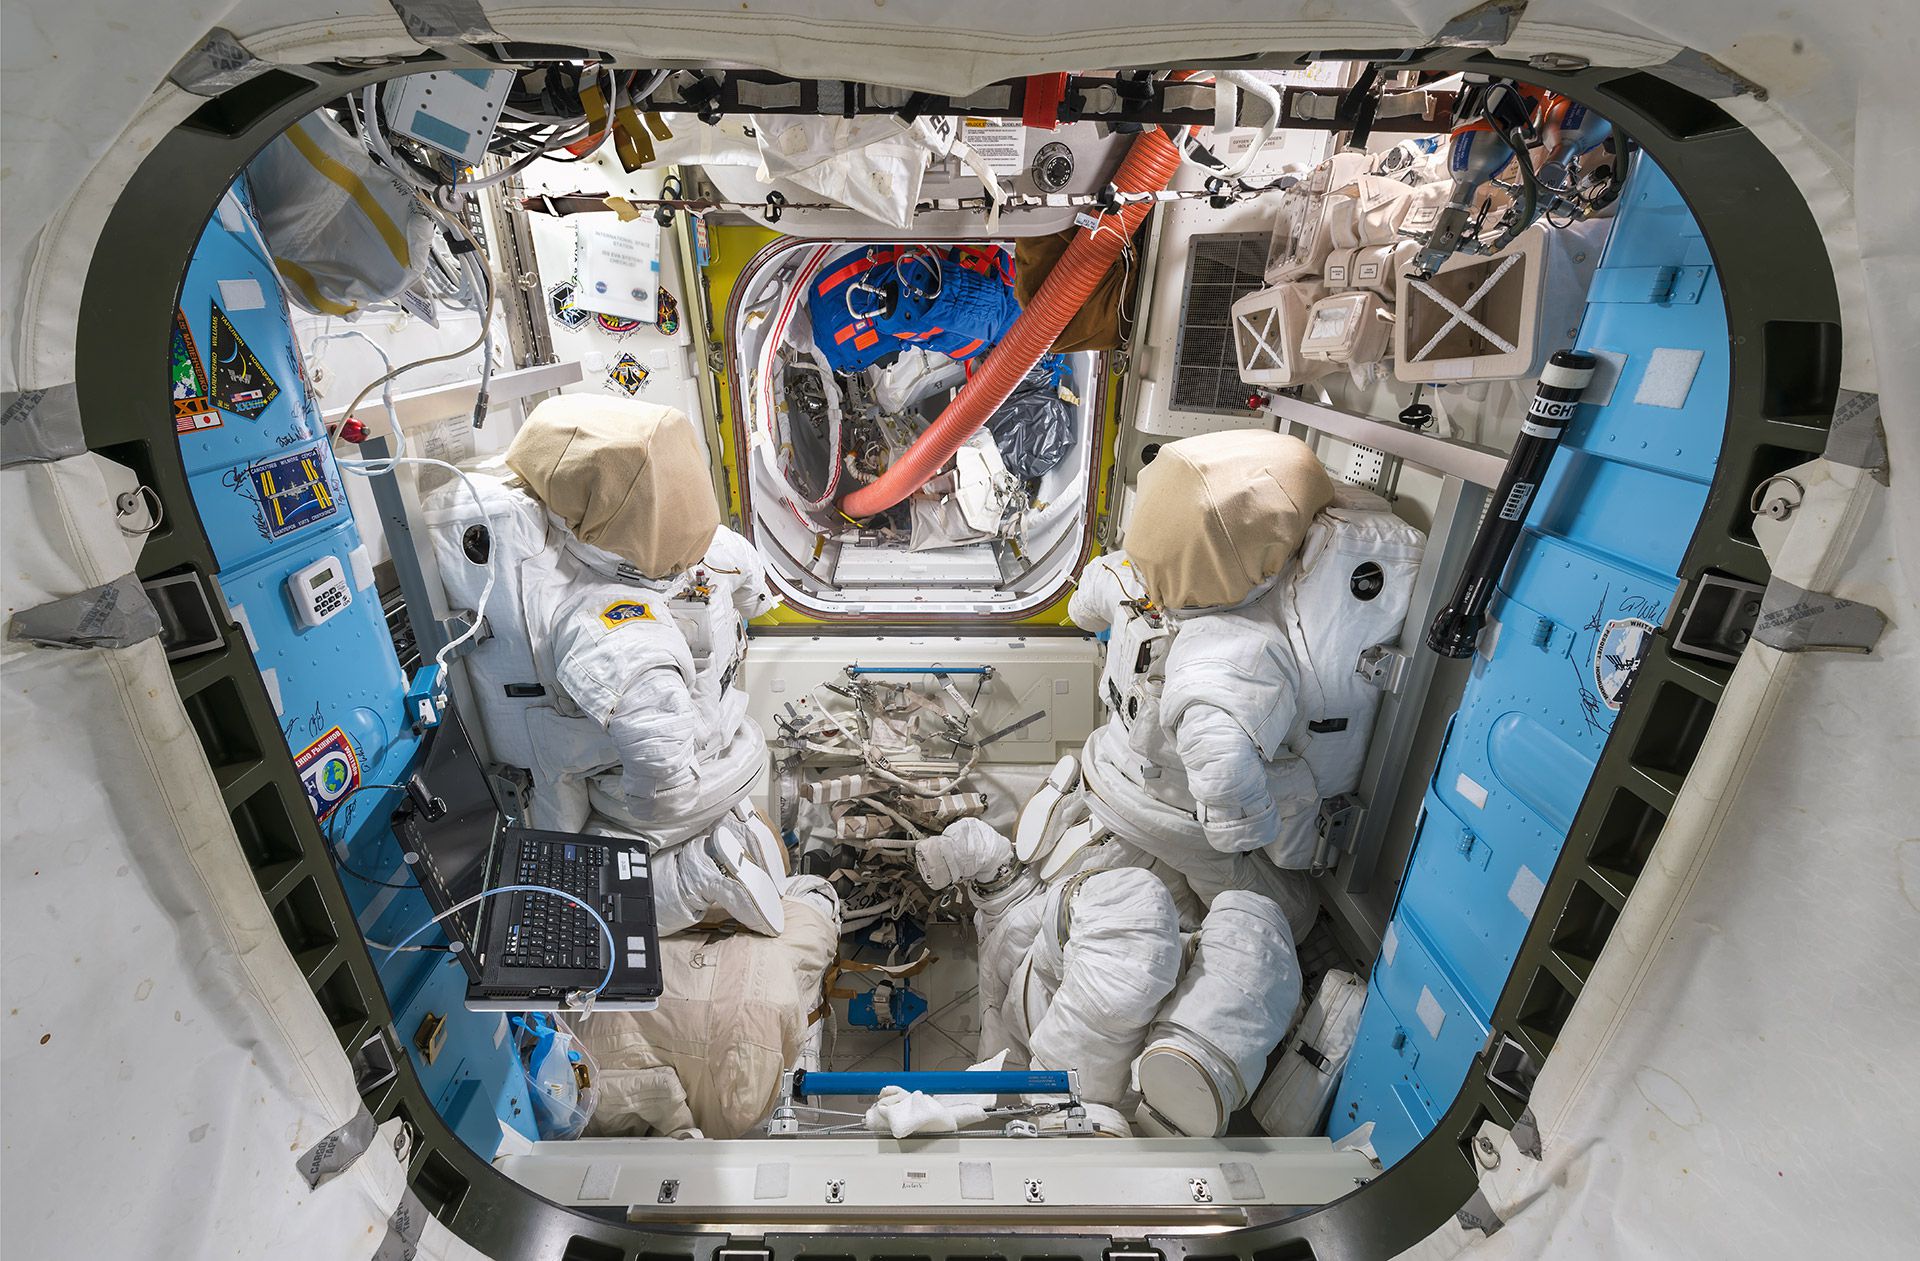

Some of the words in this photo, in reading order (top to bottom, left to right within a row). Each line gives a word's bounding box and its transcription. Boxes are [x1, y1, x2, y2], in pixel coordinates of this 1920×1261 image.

[409, 14, 437, 36] PIT
[203, 41, 243, 59] RGO
[595, 231, 633, 244] INTERNATIONAL
[613, 241, 634, 250] STATION
[310, 1140, 328, 1174] CARGO
[323, 1136, 340, 1159] TAPE
